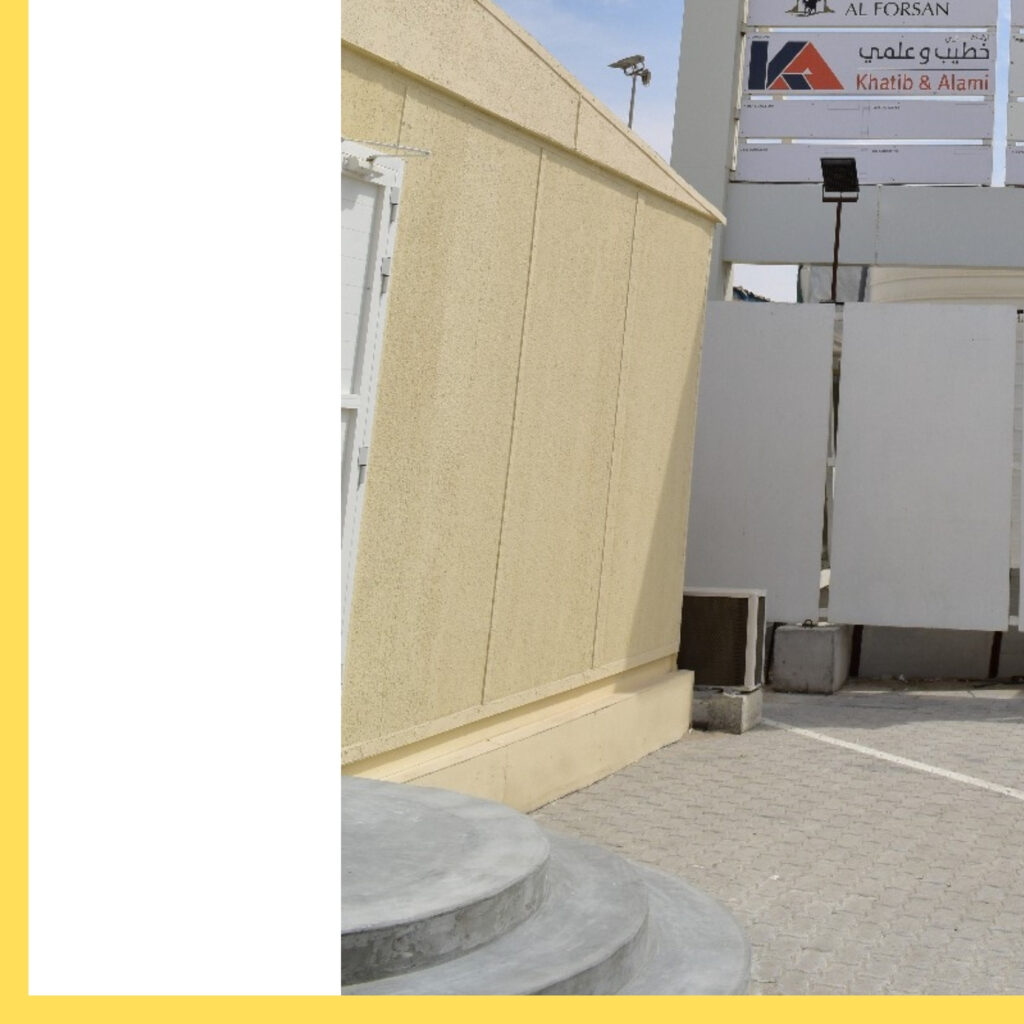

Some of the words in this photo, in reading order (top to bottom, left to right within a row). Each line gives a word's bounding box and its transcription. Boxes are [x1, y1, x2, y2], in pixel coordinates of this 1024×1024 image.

[845, 2, 868, 16] AL
[874, 1, 949, 16] FORSAN
[856, 74, 914, 91] Khatib
[918, 75, 932, 91] &
[937, 74, 990, 91] Alami
